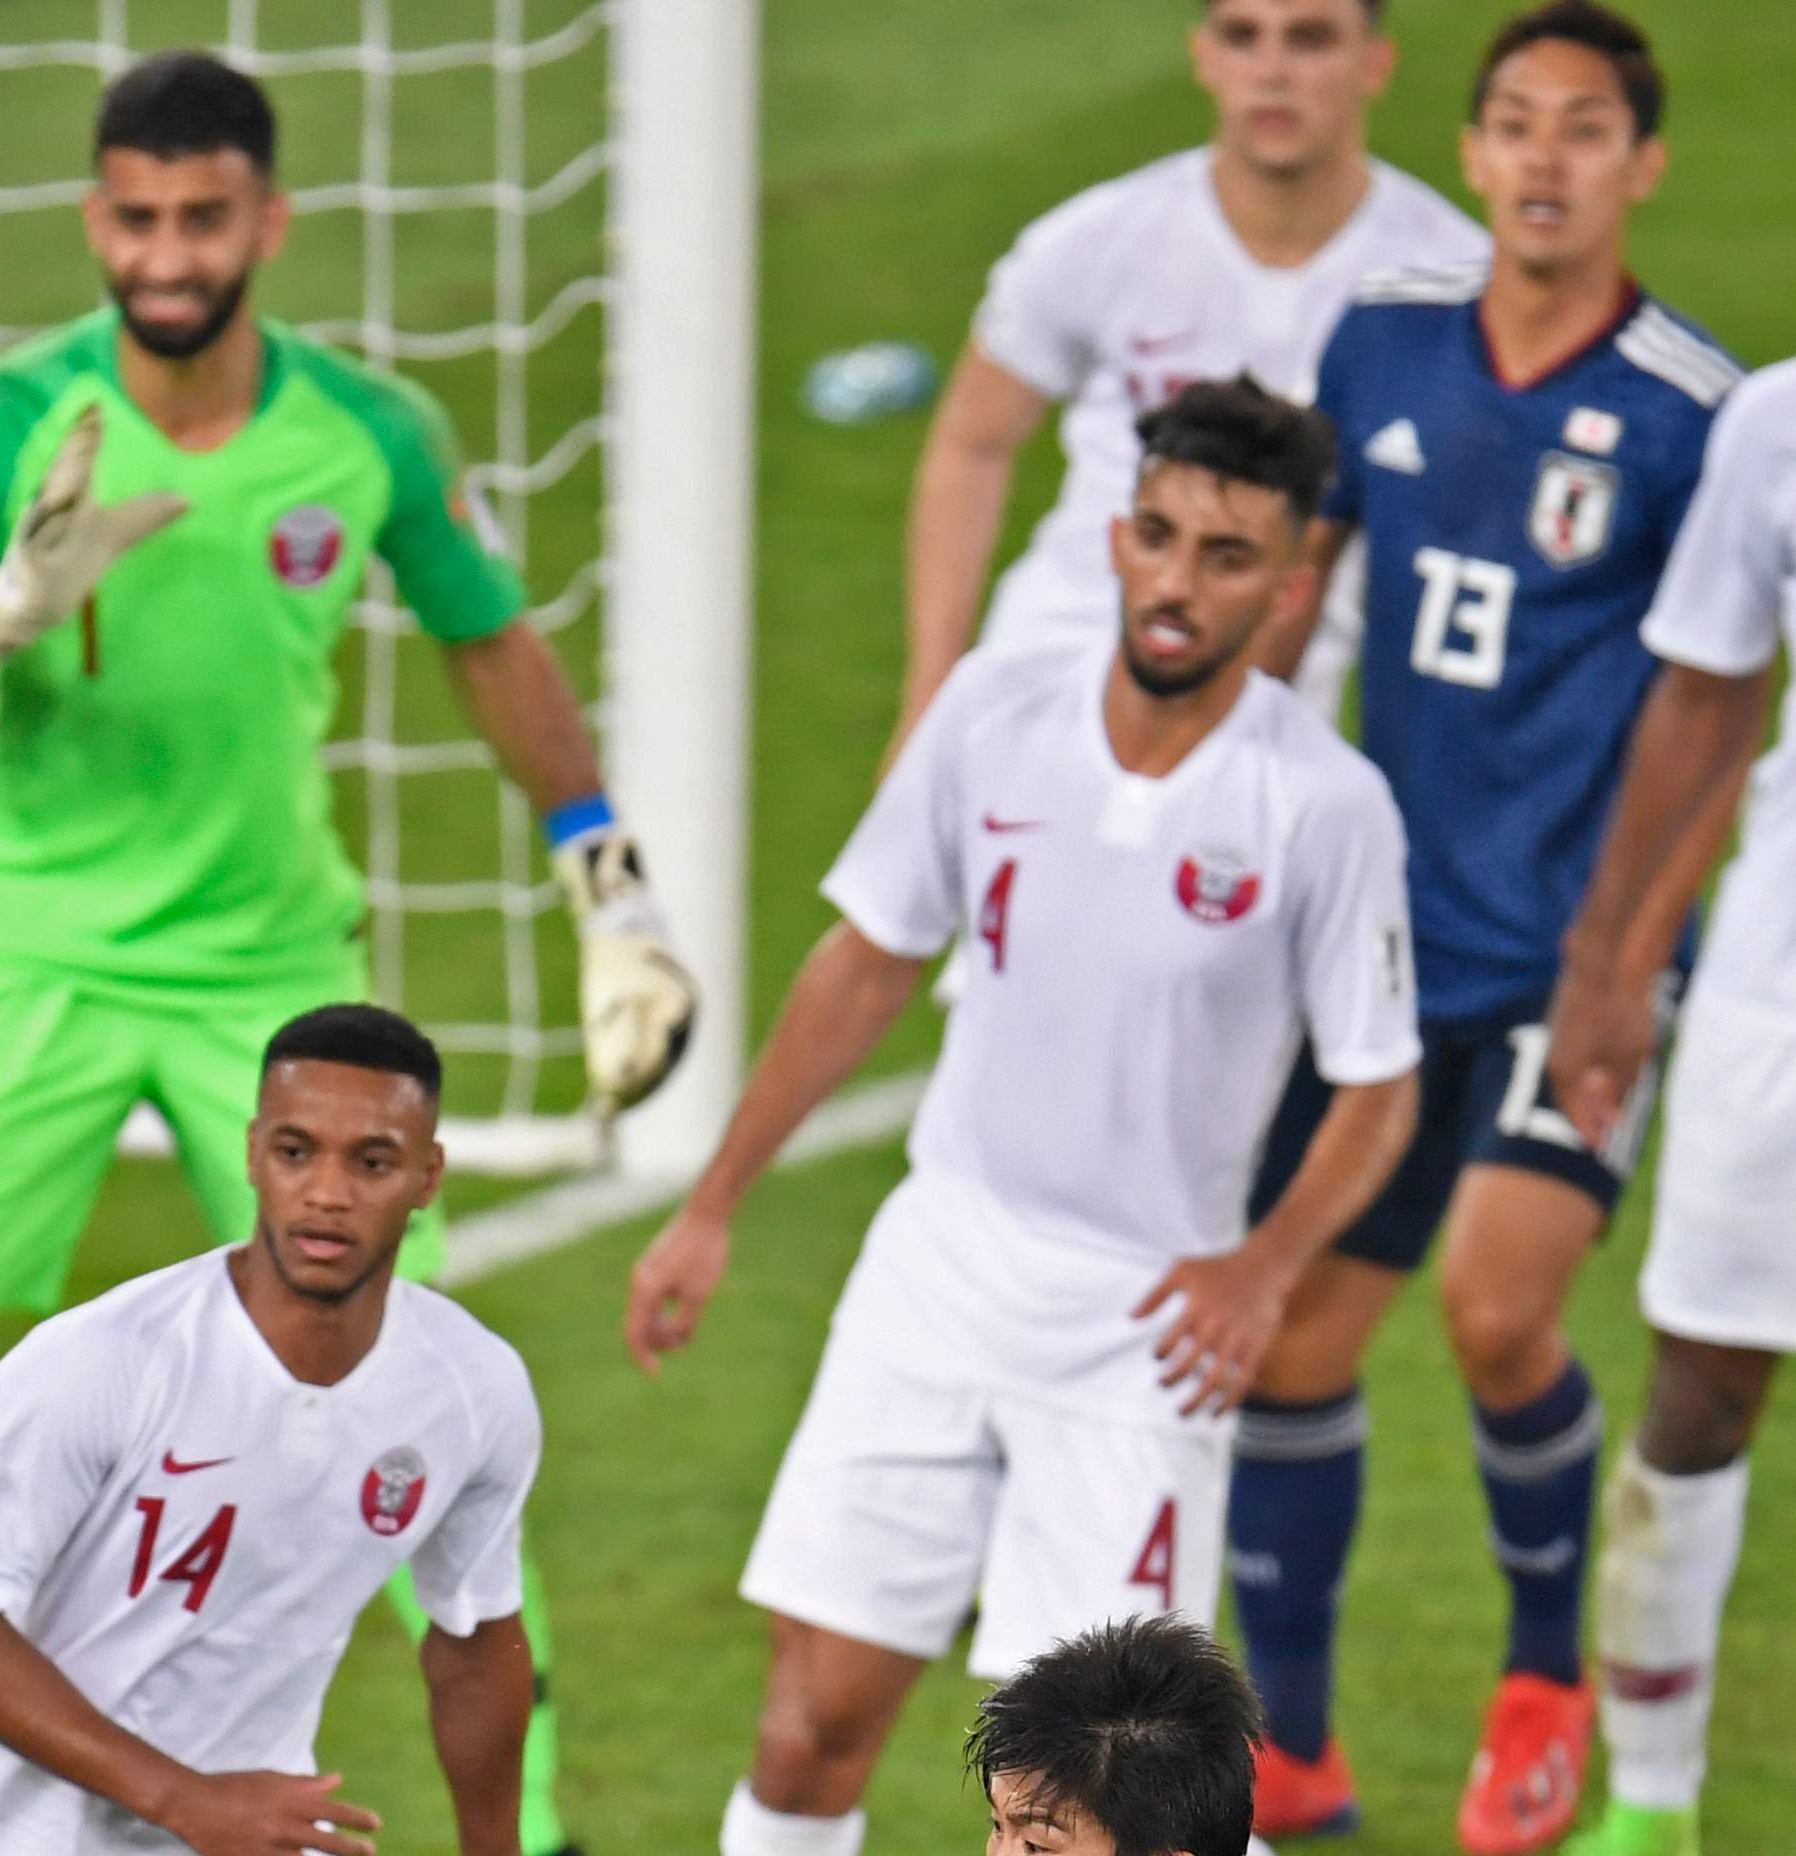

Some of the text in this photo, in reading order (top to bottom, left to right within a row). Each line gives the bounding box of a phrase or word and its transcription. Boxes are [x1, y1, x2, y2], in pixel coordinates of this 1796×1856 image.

[1410, 546, 1519, 690] 13
[978, 856, 1017, 975] 4
[128, 1497, 237, 1613] 14
[1128, 1497, 1179, 1611] 4
